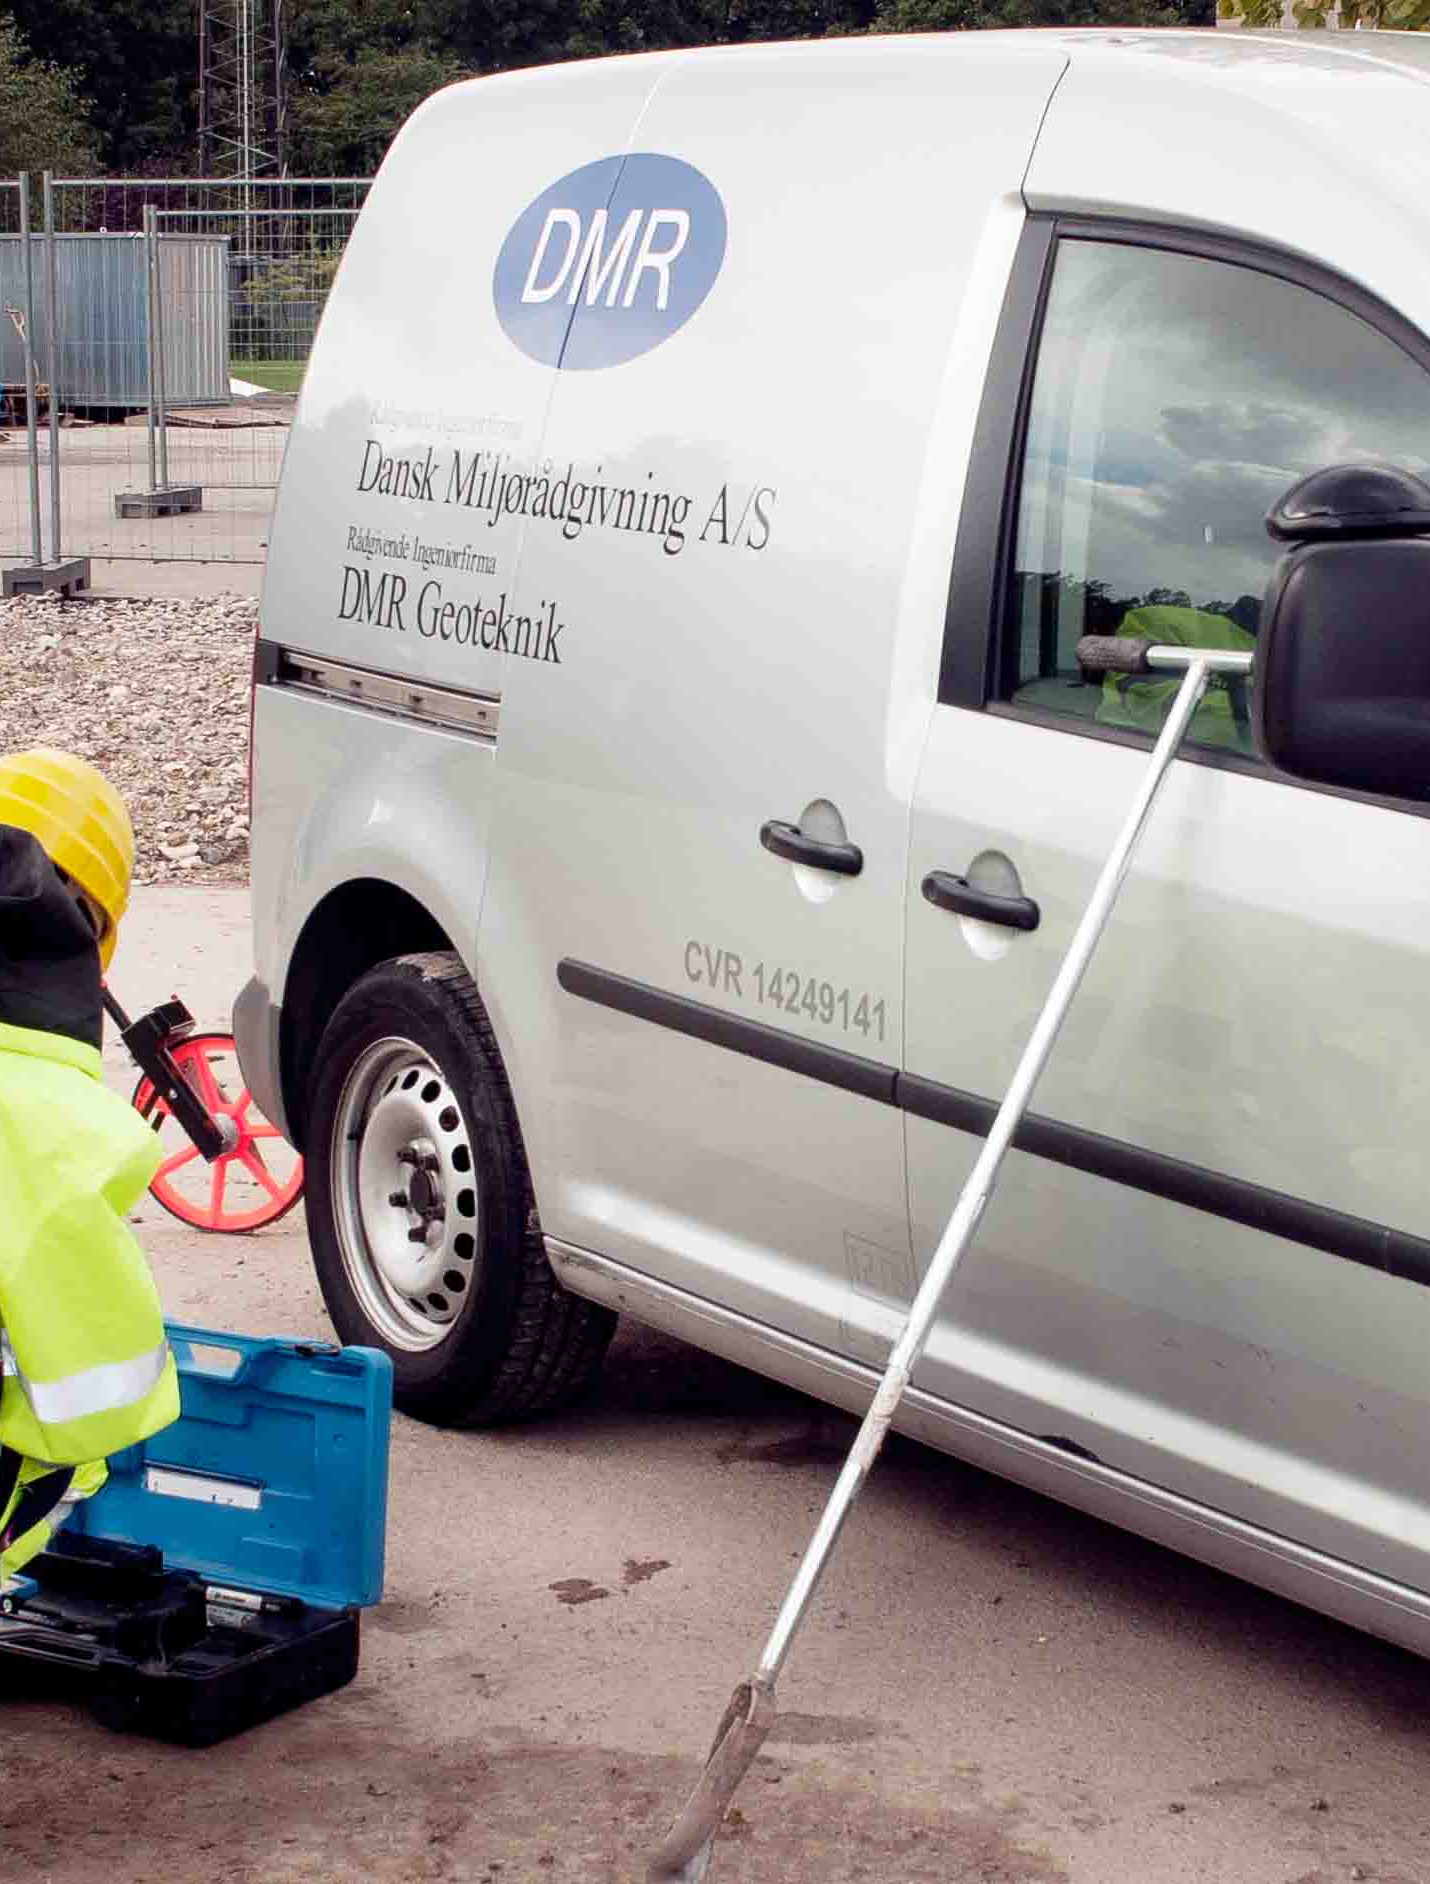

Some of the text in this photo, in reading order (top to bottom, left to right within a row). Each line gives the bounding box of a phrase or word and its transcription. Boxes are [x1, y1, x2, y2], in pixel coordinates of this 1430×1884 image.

[520, 208, 690, 311] DMR
[356, 439, 777, 555] Dansk Miljørådgivning A/S
[338, 566, 564, 664] DMR Geoteknik
[684, 940, 885, 1042] CVR 14249141
